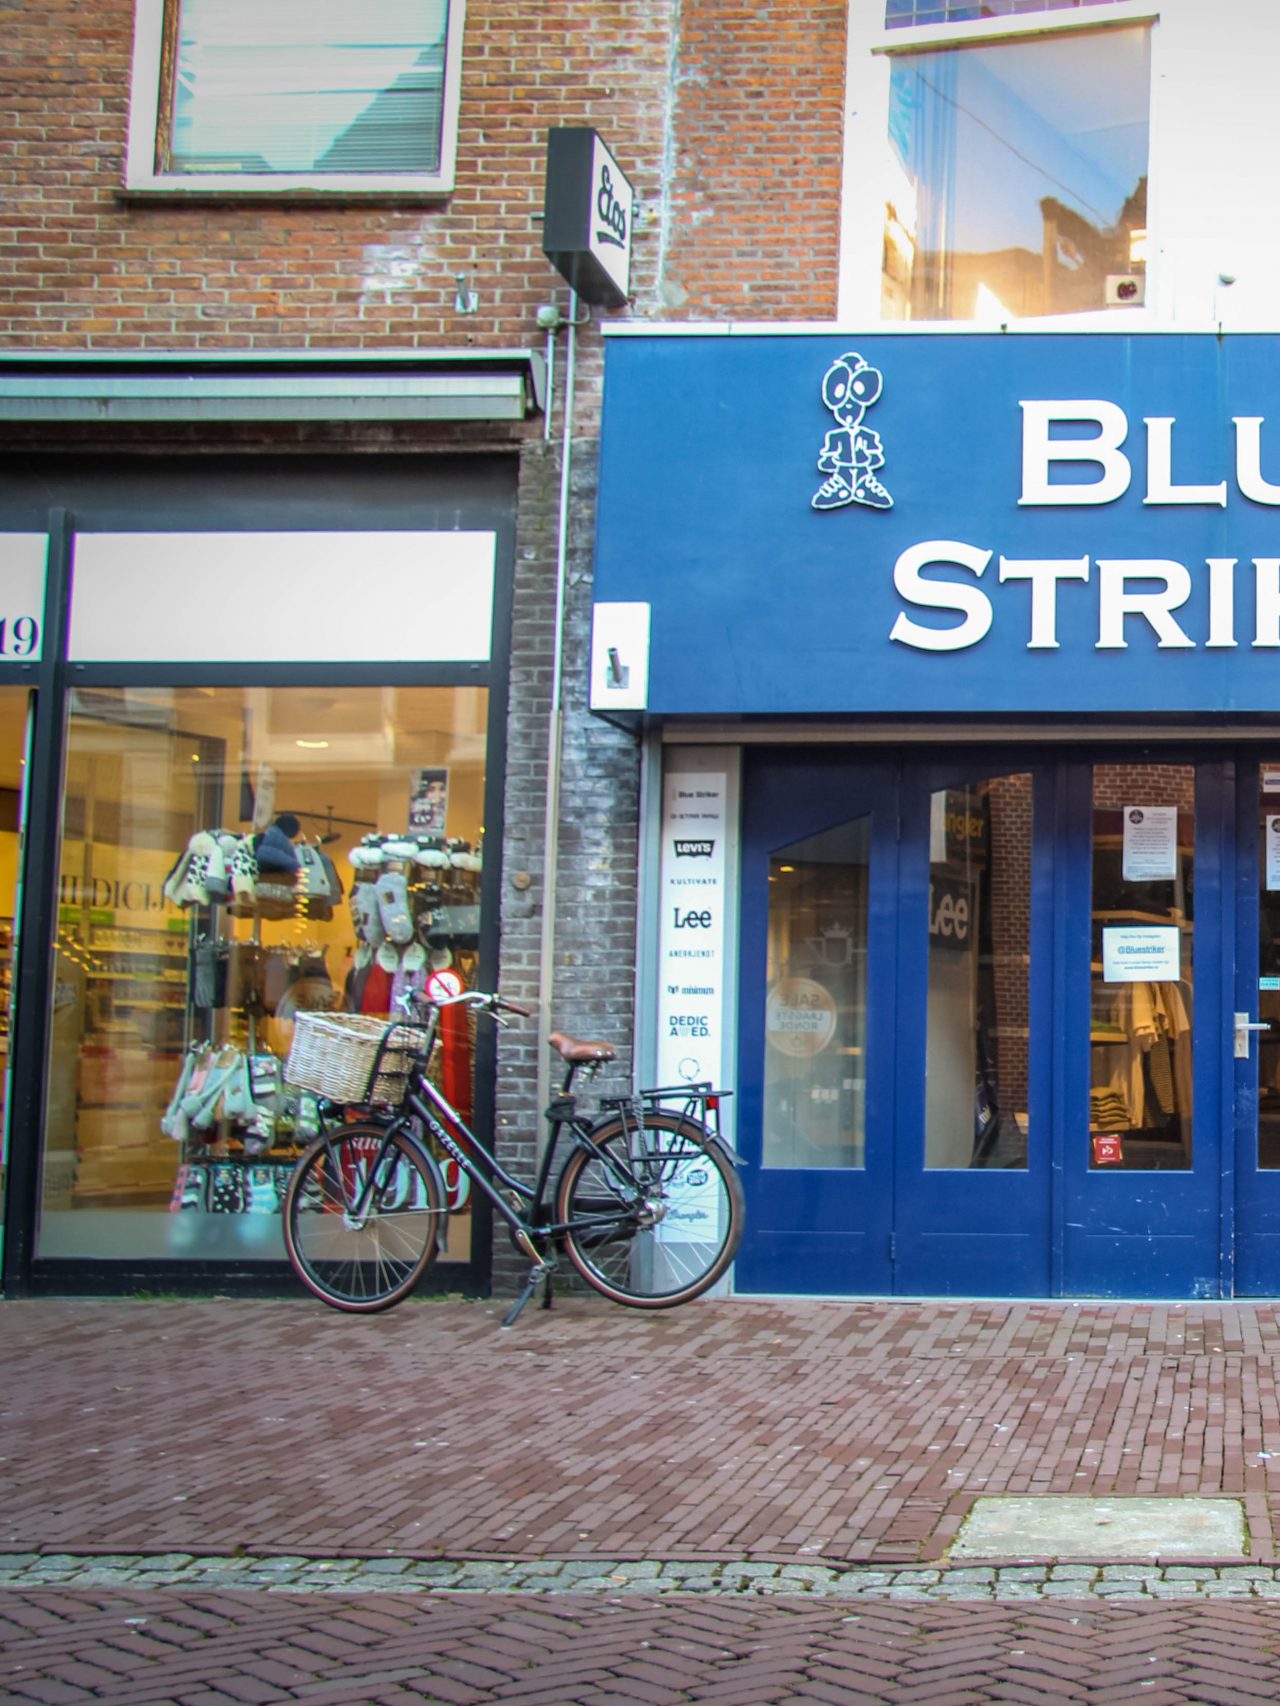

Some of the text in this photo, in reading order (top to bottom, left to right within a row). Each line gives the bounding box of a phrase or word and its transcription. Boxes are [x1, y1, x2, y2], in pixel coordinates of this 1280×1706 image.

[673, 907, 712, 928] Lee
[668, 1015, 709, 1026] DEDIC
[428, 1120, 473, 1169] GAZELLE
